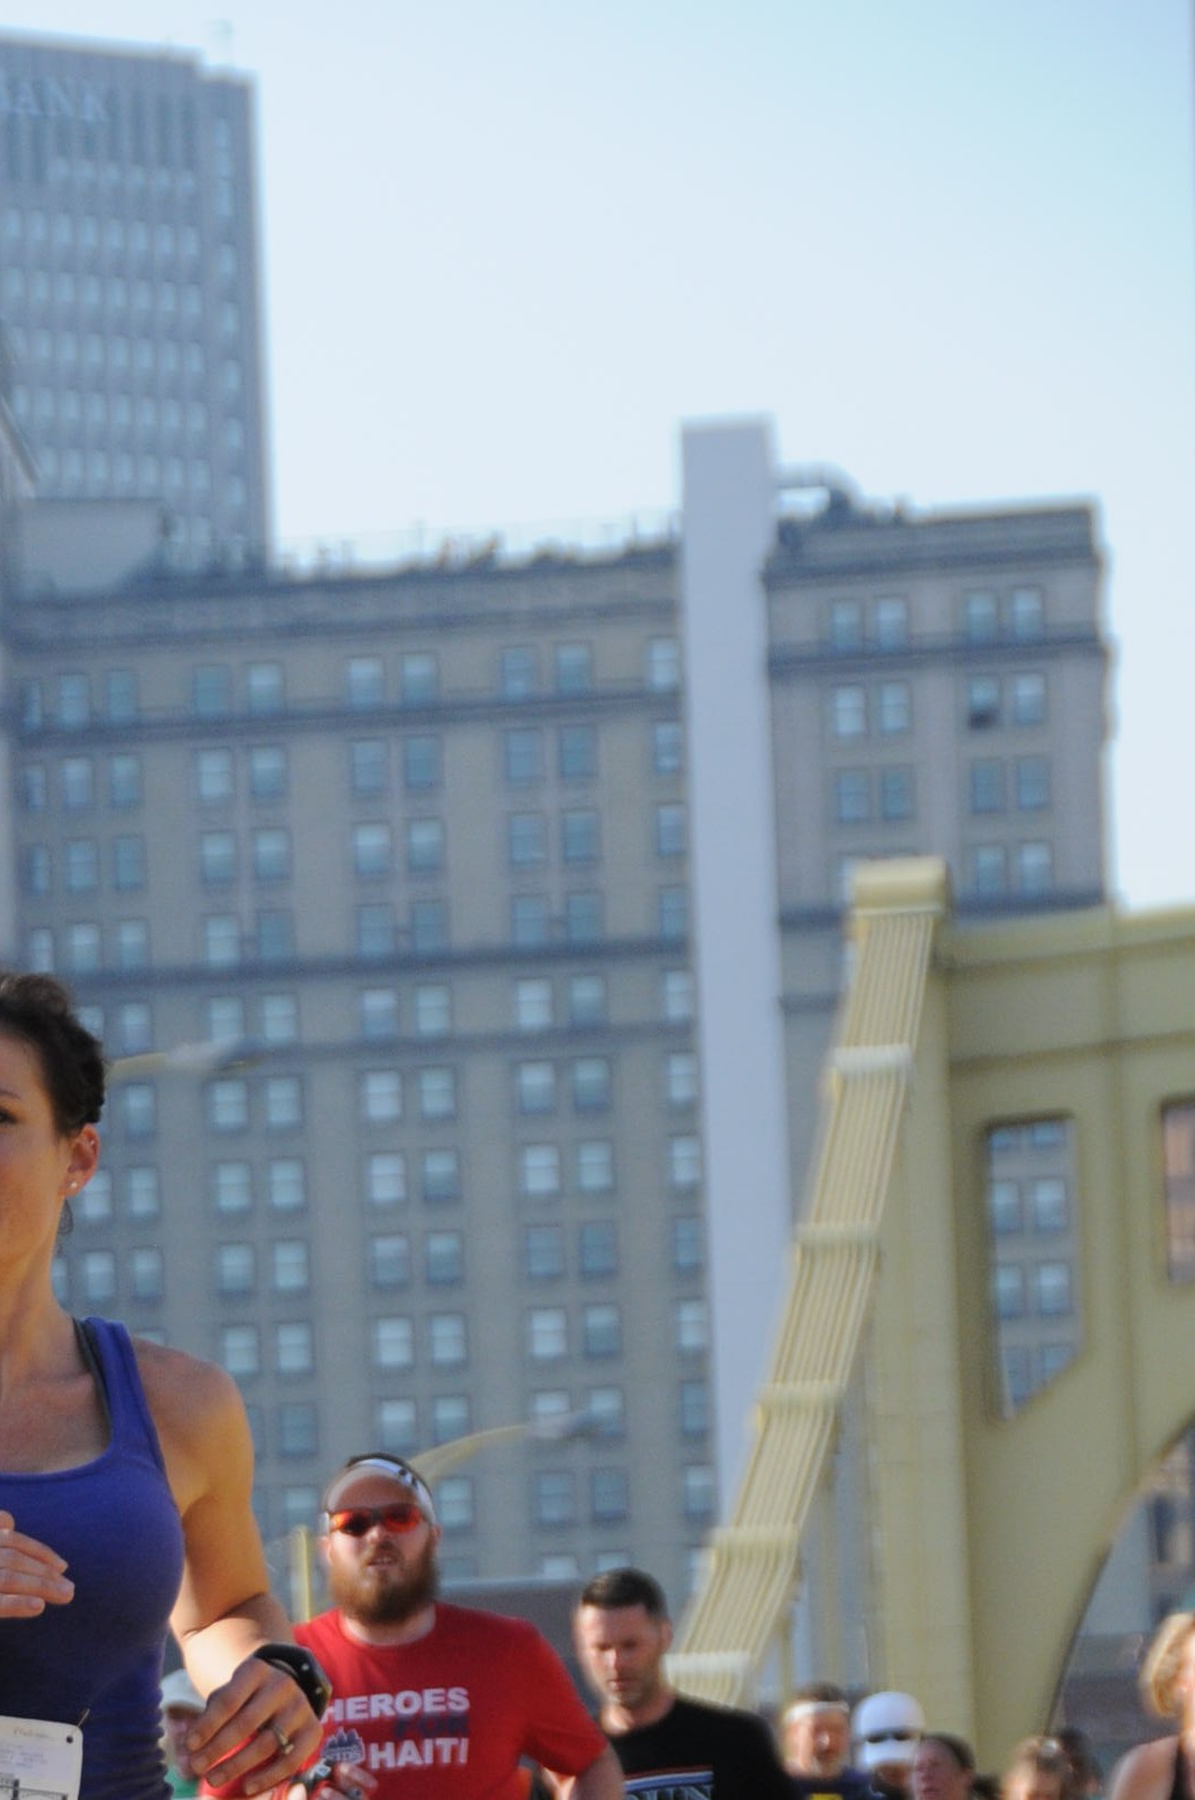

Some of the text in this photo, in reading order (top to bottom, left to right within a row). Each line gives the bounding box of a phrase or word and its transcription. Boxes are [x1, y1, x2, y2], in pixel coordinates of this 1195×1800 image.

[320, 1687, 470, 1724] HEROES
[395, 1716, 468, 1739] FOR
[367, 1737, 469, 1769] HAITI
